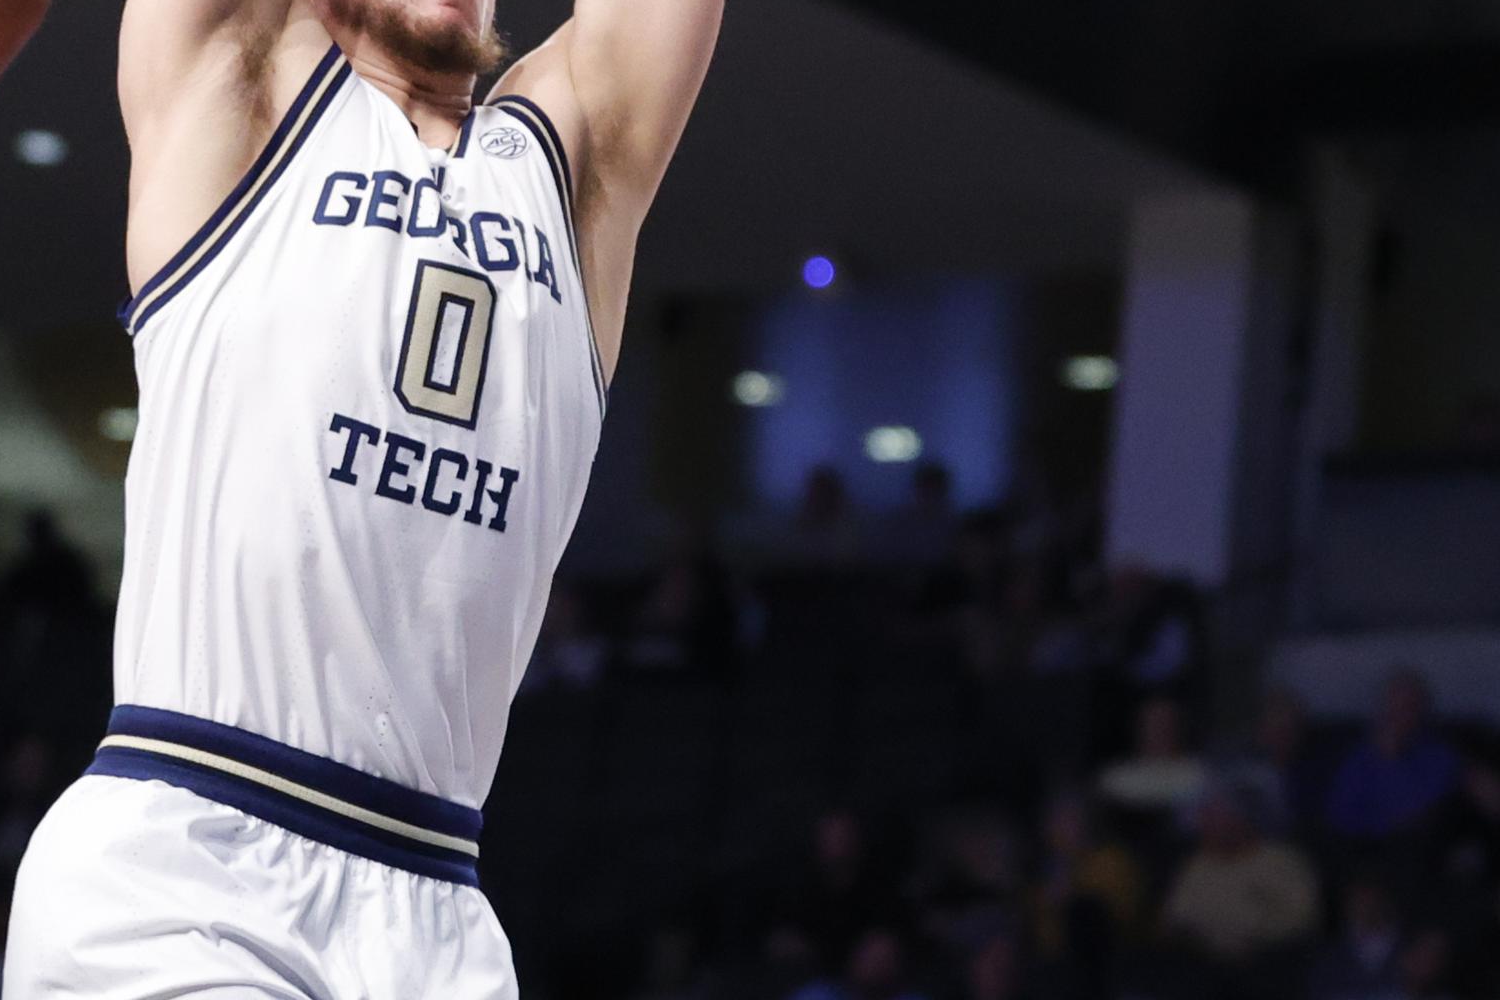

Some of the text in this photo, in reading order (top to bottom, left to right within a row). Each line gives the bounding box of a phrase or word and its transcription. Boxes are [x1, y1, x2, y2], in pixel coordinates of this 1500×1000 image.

[312, 170, 562, 304] GEORGIA
[393, 258, 498, 430] 0
[329, 413, 520, 533] TECH
